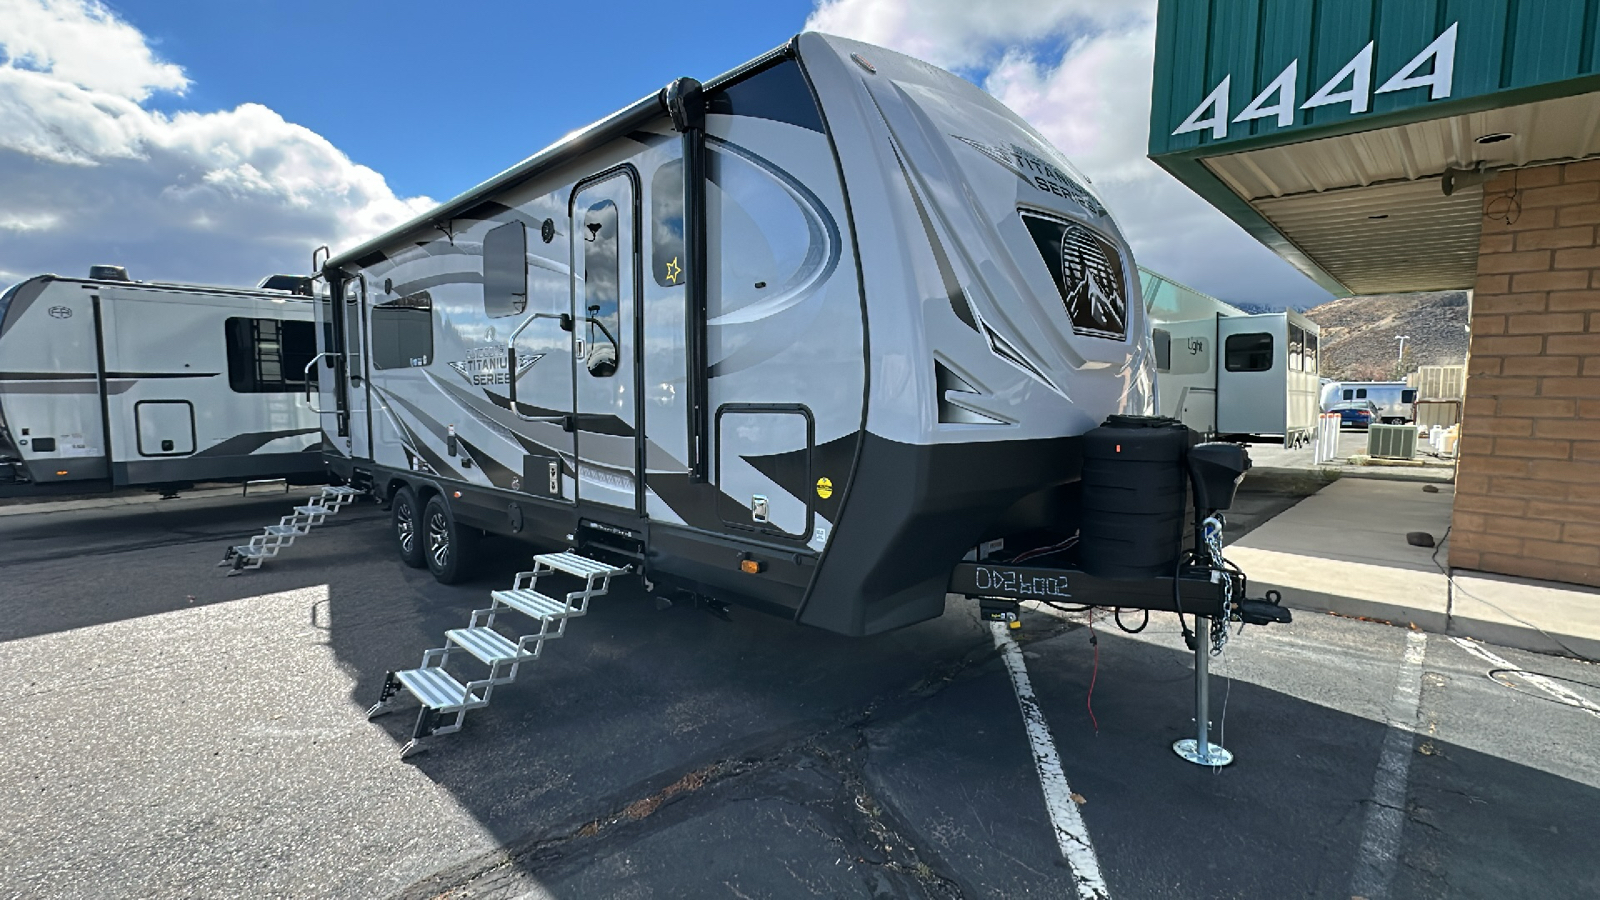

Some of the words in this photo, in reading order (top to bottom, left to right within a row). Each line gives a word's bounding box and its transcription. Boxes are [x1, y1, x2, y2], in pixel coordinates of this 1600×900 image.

[1171, 21, 1458, 140] 4444
[1034, 176, 1097, 214] SERIES
[467, 356, 518, 371] TITANIU
